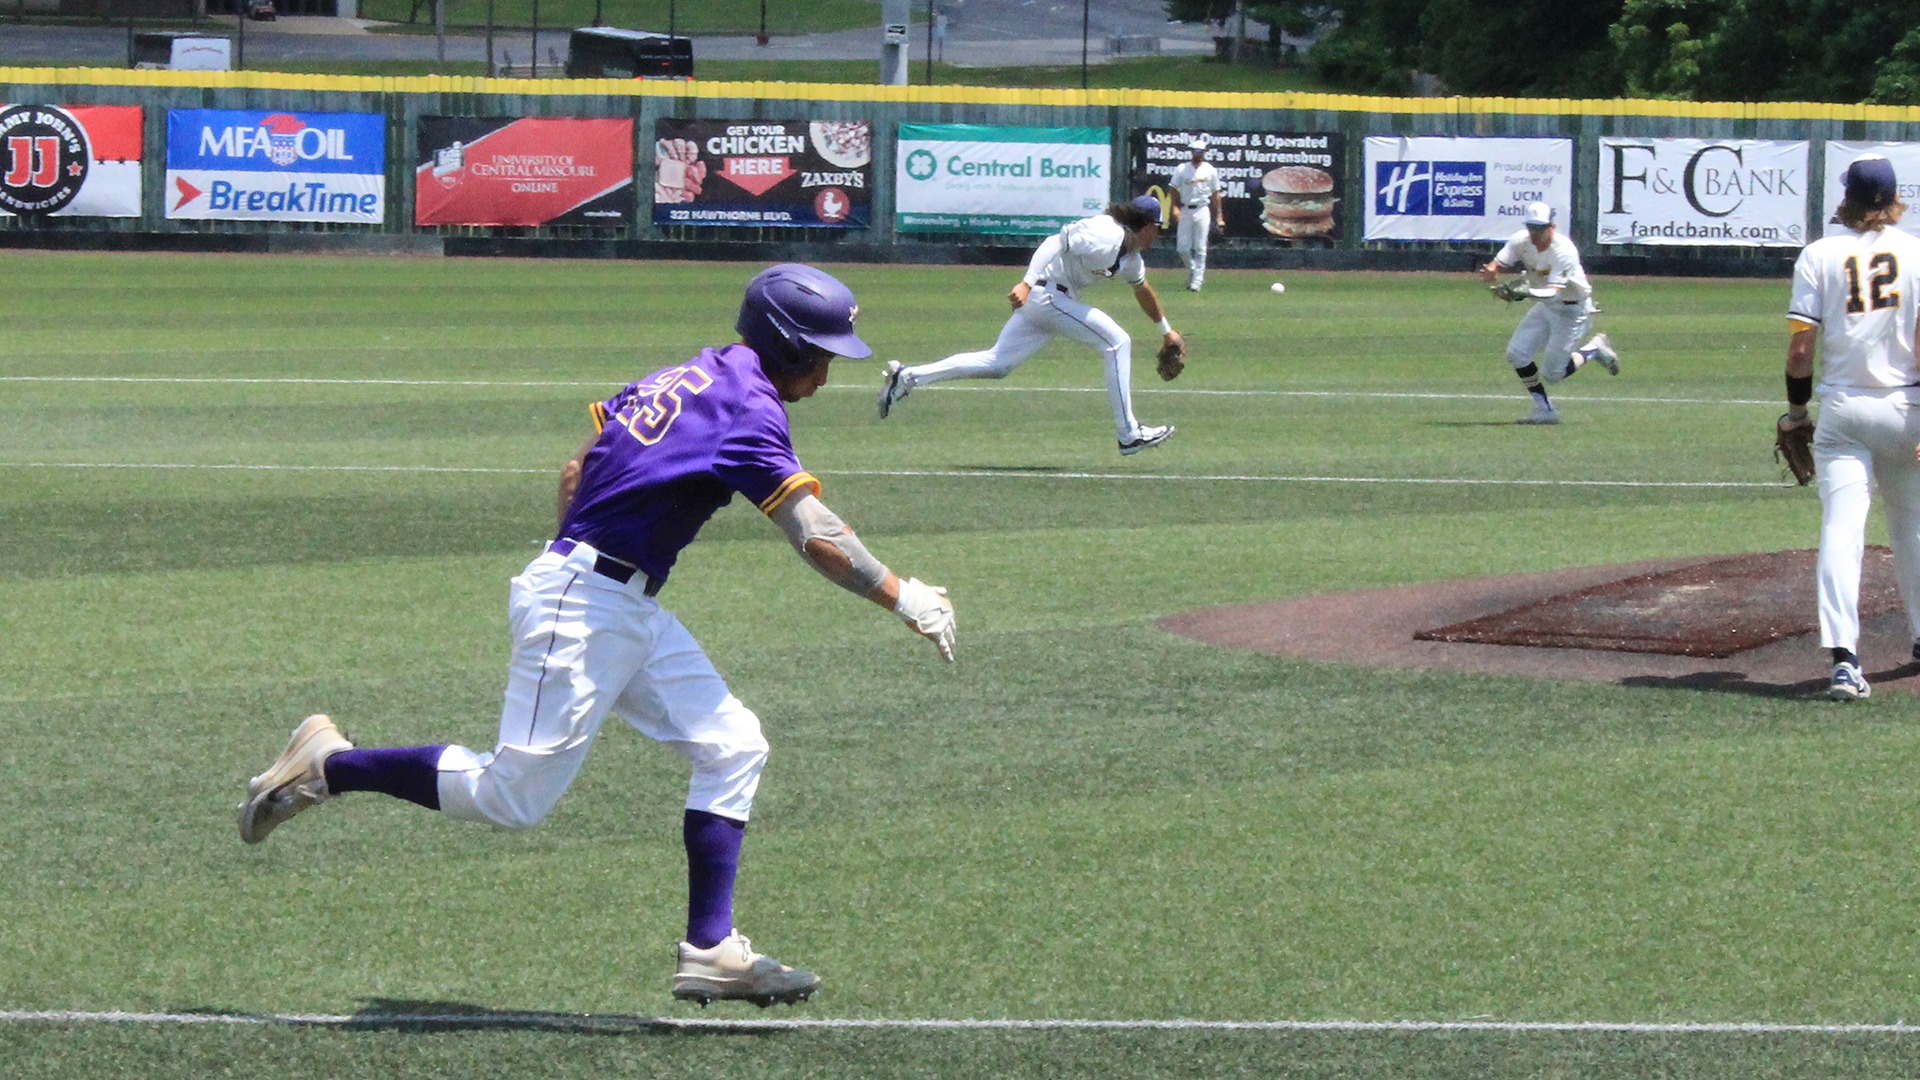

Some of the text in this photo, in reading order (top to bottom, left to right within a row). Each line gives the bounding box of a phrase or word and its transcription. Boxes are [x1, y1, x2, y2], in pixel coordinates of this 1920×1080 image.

[35, 111, 81, 153] JOHN'S
[726, 125, 785, 136] GET YOUR
[198, 126, 353, 160] MFA OIL
[706, 136, 805, 155] CHICKEN
[1146, 131, 1328, 150] Locally Owned & Operated
[4, 136, 60, 187] JJ
[1146, 146, 1332, 167] McDond's of Warrensburg
[471, 163, 596, 177] CENTRAL MISSOURI
[730, 159, 783, 175] HERE
[947, 155, 1102, 178] Central Bank
[1146, 162, 1262, 180] Prou pports
[1494, 162, 1563, 175] Proud Lodging
[511, 182, 558, 193] ONLINE
[801, 171, 864, 188] ZAXBY'S
[1504, 175, 1554, 187] Partner of
[209, 180, 377, 213] BreakTime
[1219, 181, 1251, 199] CM.
[1435, 183, 1483, 198] Express
[1512, 191, 1543, 202] UCM
[670, 210, 690, 220] 322
[1497, 204, 1557, 217] Athls
[1631, 220, 1779, 239] fandcbank.com
[1845, 252, 1901, 314] 12
[616, 365, 714, 446] 25
